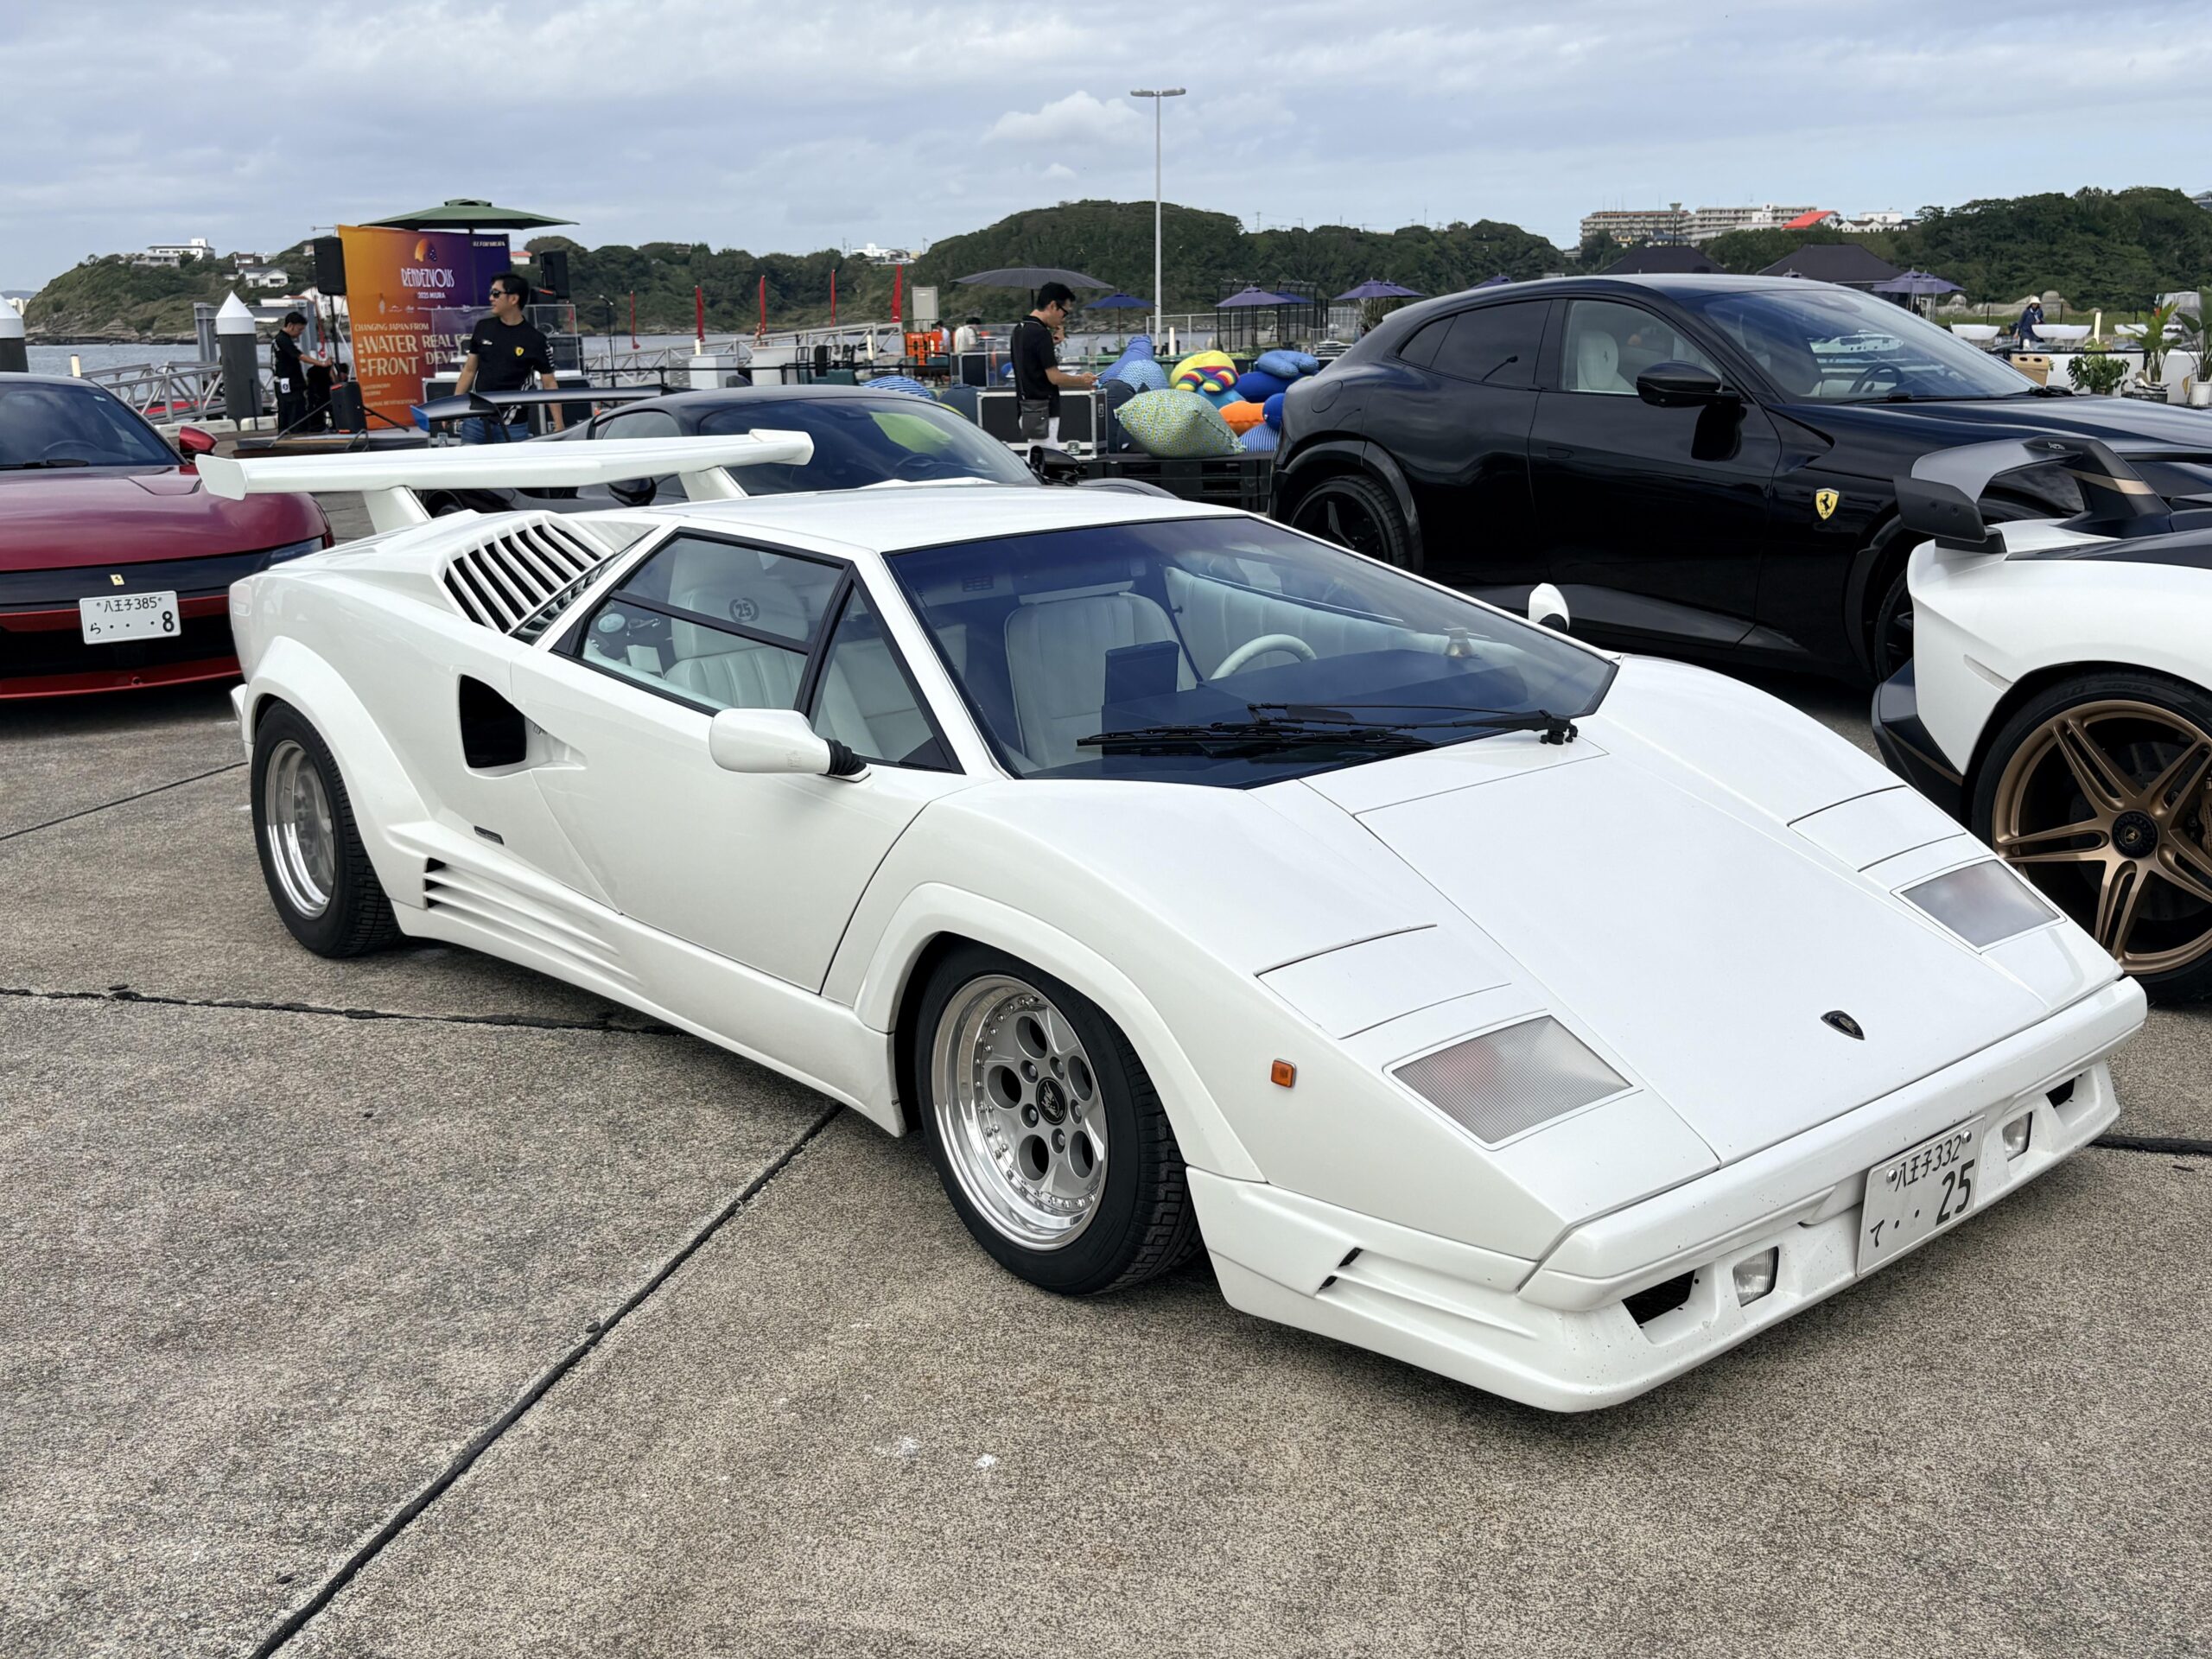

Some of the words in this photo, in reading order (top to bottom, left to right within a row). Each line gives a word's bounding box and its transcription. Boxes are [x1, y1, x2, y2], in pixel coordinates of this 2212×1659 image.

[401, 267, 454, 288] RENDEZVOUS
[354, 323, 387, 332] CHANGING
[410, 322, 429, 331] FROM
[363, 334, 418, 354] WATER
[422, 334, 454, 348] REAL
[367, 356, 419, 377] FRONT
[735, 602, 753, 618] 25
[90, 622, 102, 635] ら
[1870, 1219, 1885, 1248] て
[1936, 1159, 1975, 1226] 25
